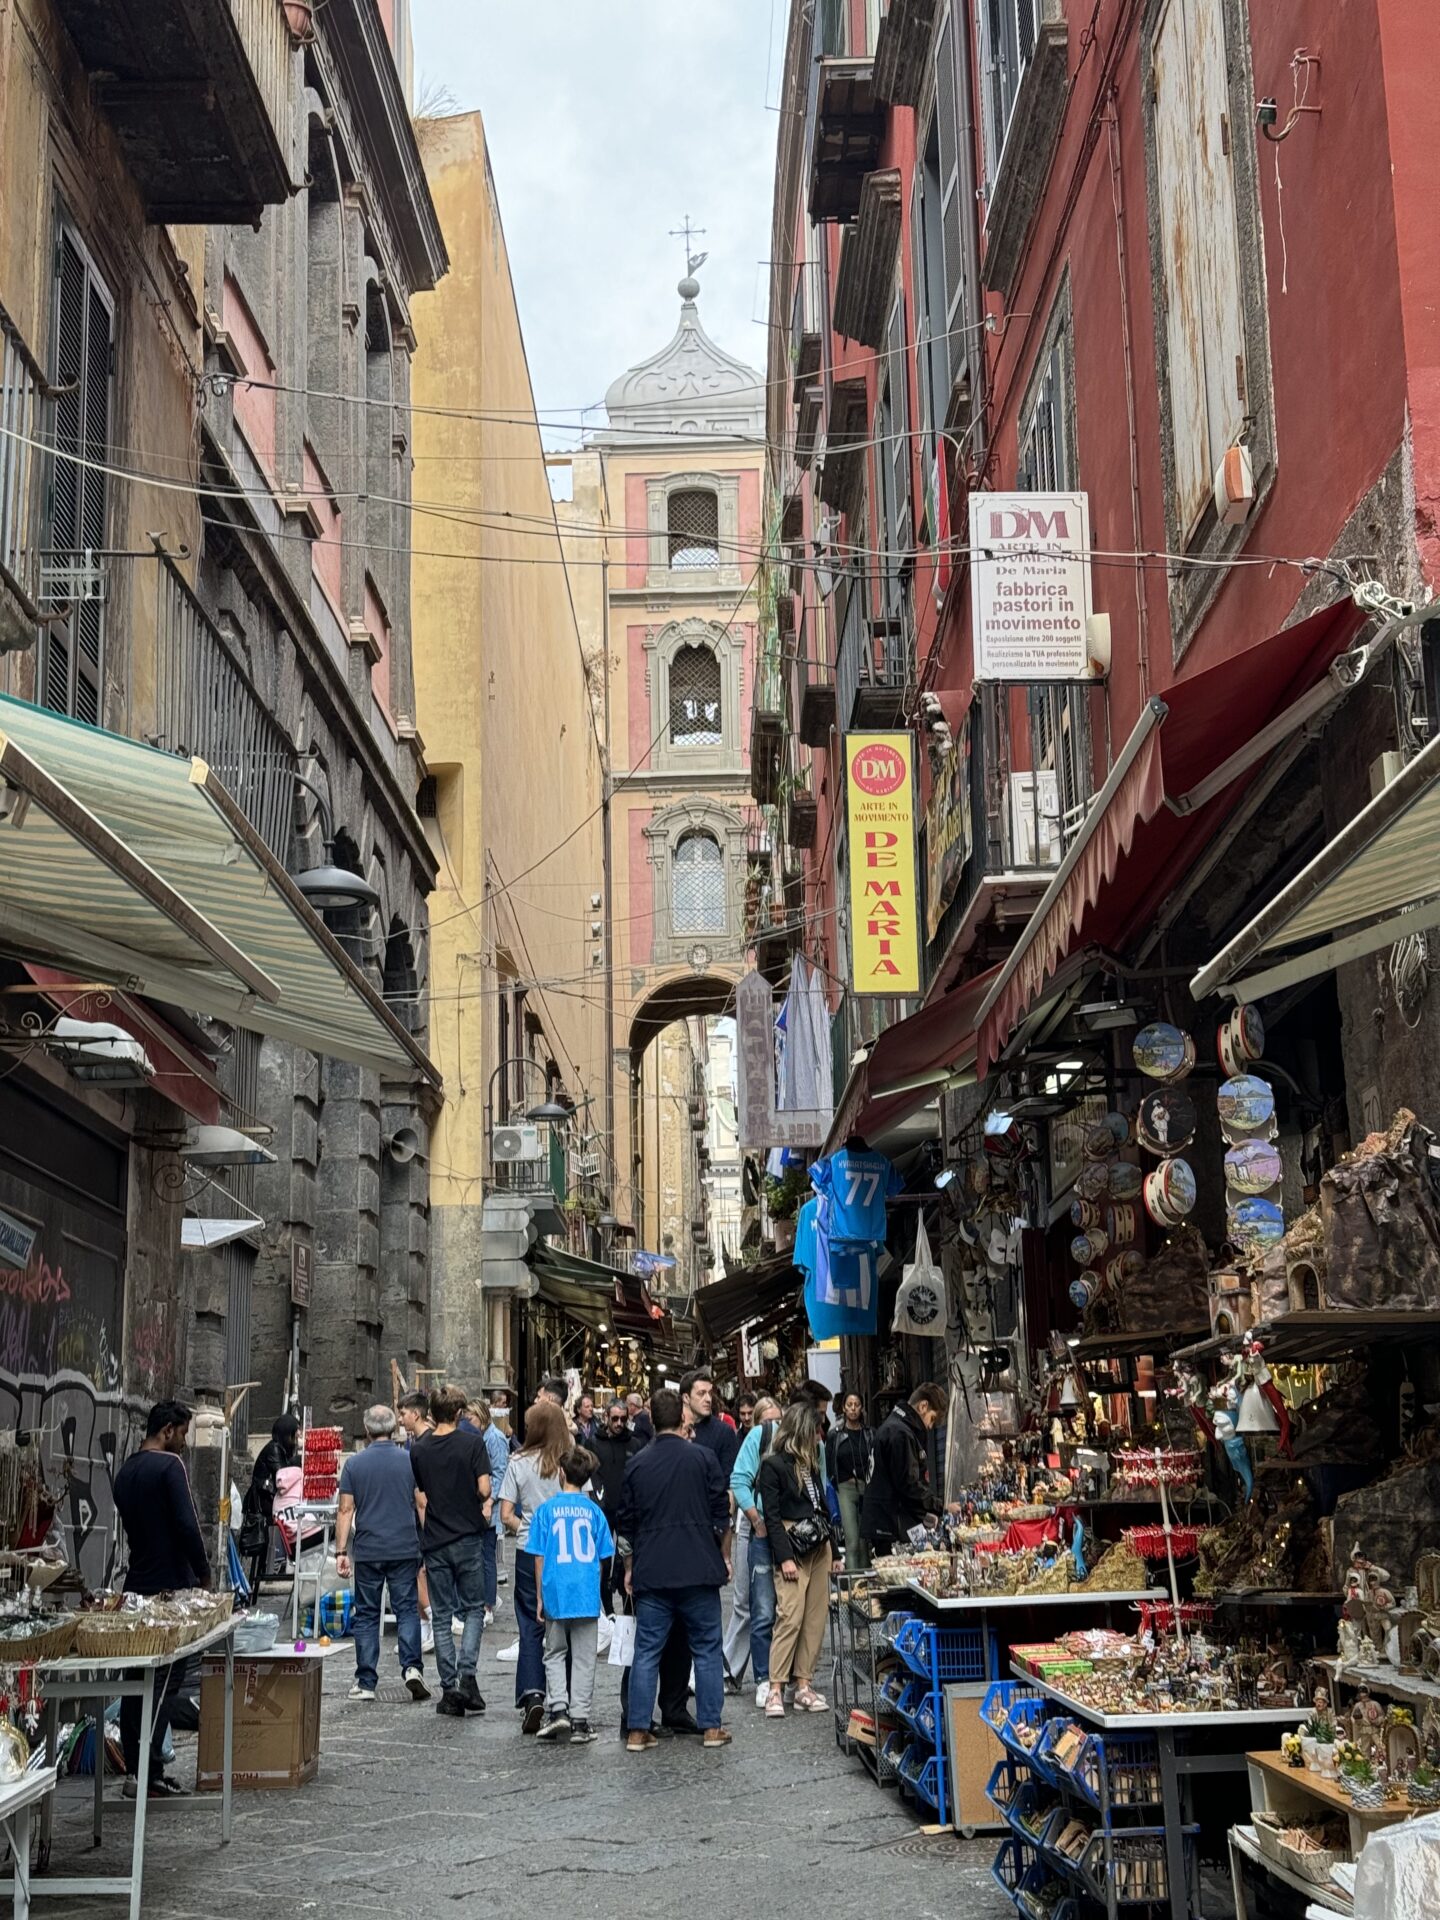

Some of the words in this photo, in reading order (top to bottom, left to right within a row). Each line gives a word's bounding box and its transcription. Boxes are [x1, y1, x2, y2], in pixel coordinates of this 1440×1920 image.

[990, 510, 1069, 539] DM
[998, 542, 1039, 552] ARTE
[1046, 542, 1062, 552] IN
[991, 553, 1079, 563] OVIMENTO
[996, 566, 1017, 576] De
[1023, 566, 1066, 576] Maria
[996, 581, 1068, 597] fabbrica
[993, 597, 1053, 616] pastori
[1058, 597, 1074, 612] in
[985, 615, 1081, 630] movimento
[986, 635, 1024, 644] Esposizione
[1055, 635, 1082, 644] soggetti
[1024, 650, 1031, 658] la
[1032, 650, 1046, 658] TUA
[1046, 650, 1082, 659] professione
[992, 660, 1037, 669] personalizzata
[1045, 660, 1079, 668] movimento
[861, 759, 897, 779] DM
[859, 802, 886, 811] ARTE
[888, 802, 898, 811] IN
[853, 812, 909, 822] MOVIMENTO
[864, 831, 899, 868] DE
[864, 880, 902, 976] MARIA
[845, 1171, 880, 1207] 77
[552, 1506, 593, 1520] MARADONA
[552, 1517, 596, 1564] 10
[212, 1665, 248, 1674] FRGIL
[216, 1771, 259, 1779] FRAGE
